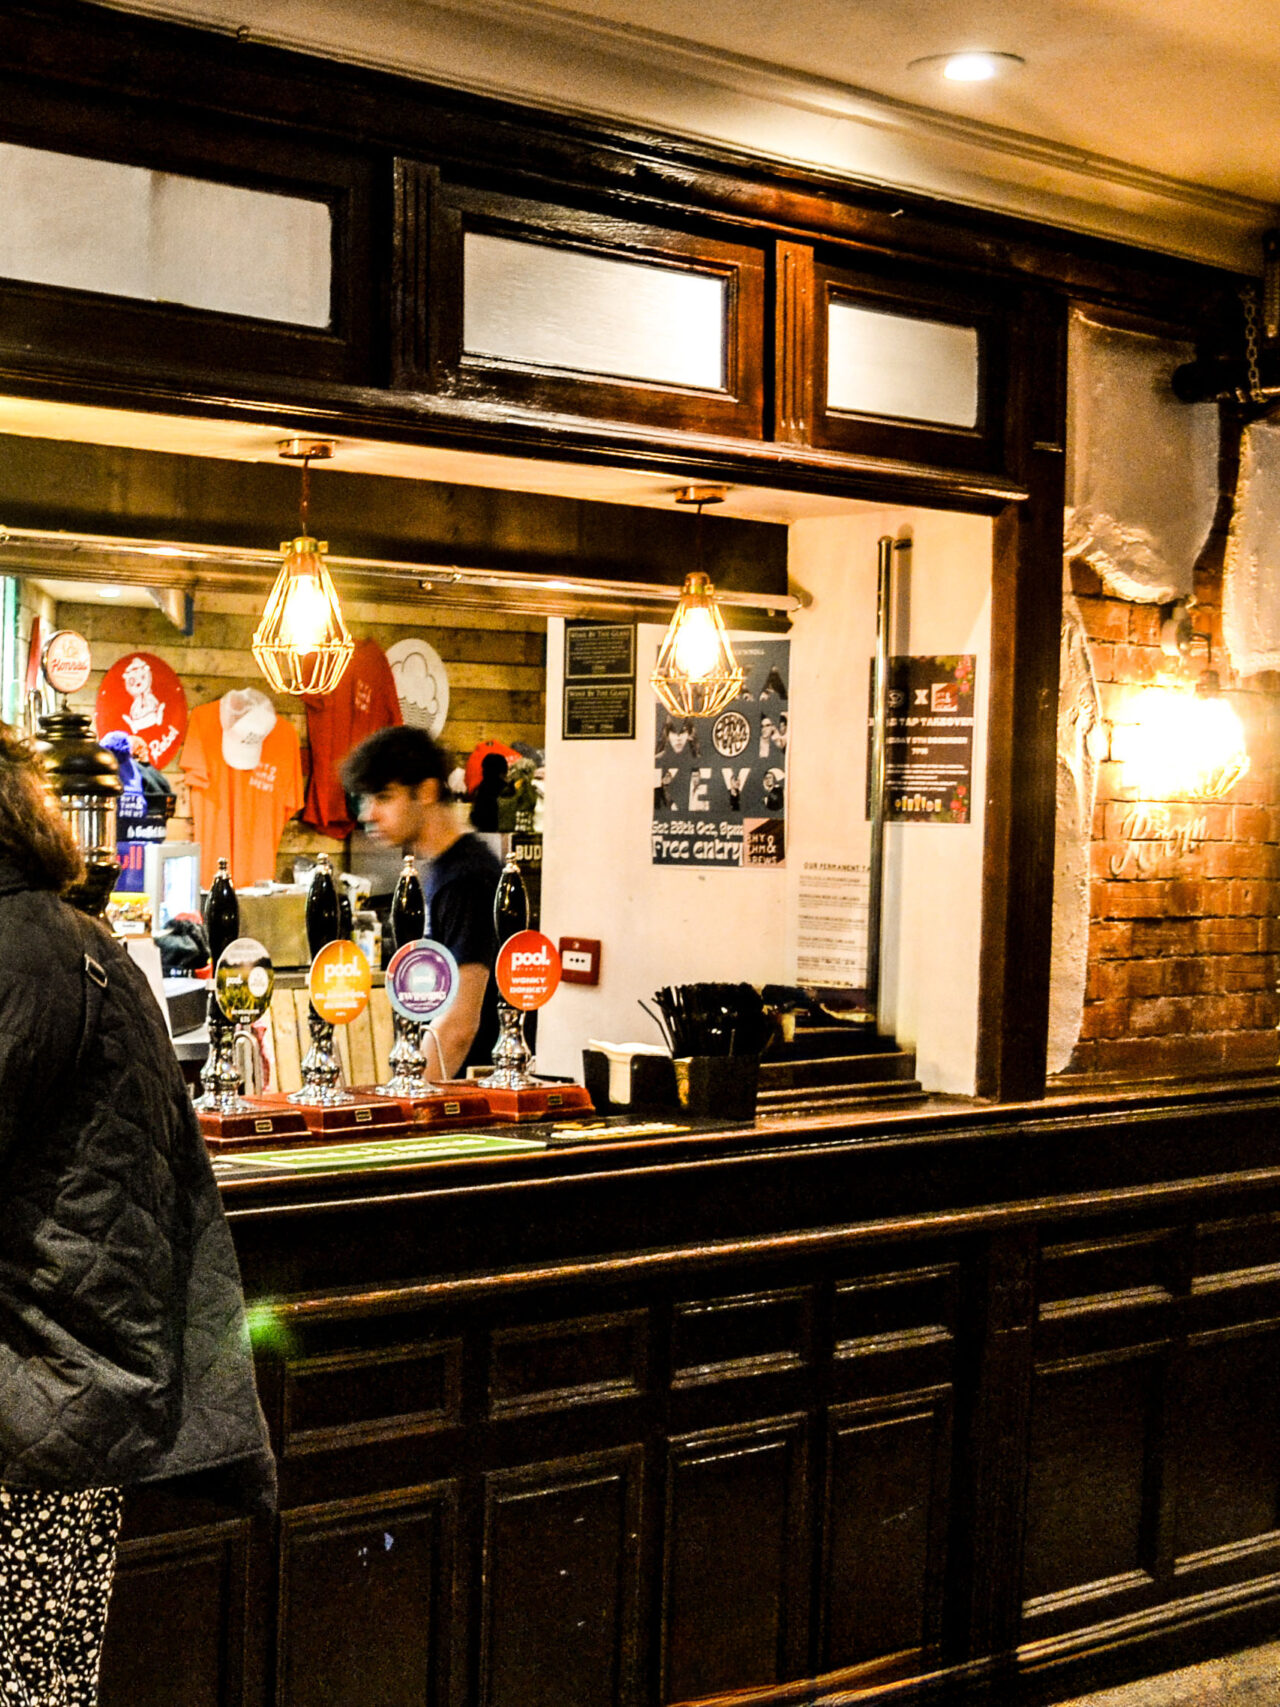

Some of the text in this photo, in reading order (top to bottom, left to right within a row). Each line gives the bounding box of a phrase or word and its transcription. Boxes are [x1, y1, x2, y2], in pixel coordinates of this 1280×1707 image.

[515, 844, 542, 860] BUD
[651, 835, 744, 867] Free entry
[803, 861, 818, 870] OUR
[819, 863, 860, 872] PERMANENT
[511, 944, 551, 971] pool.
[324, 955, 361, 983] pool.
[510, 976, 547, 985] WONKY
[509, 986, 548, 994] DONKEY
